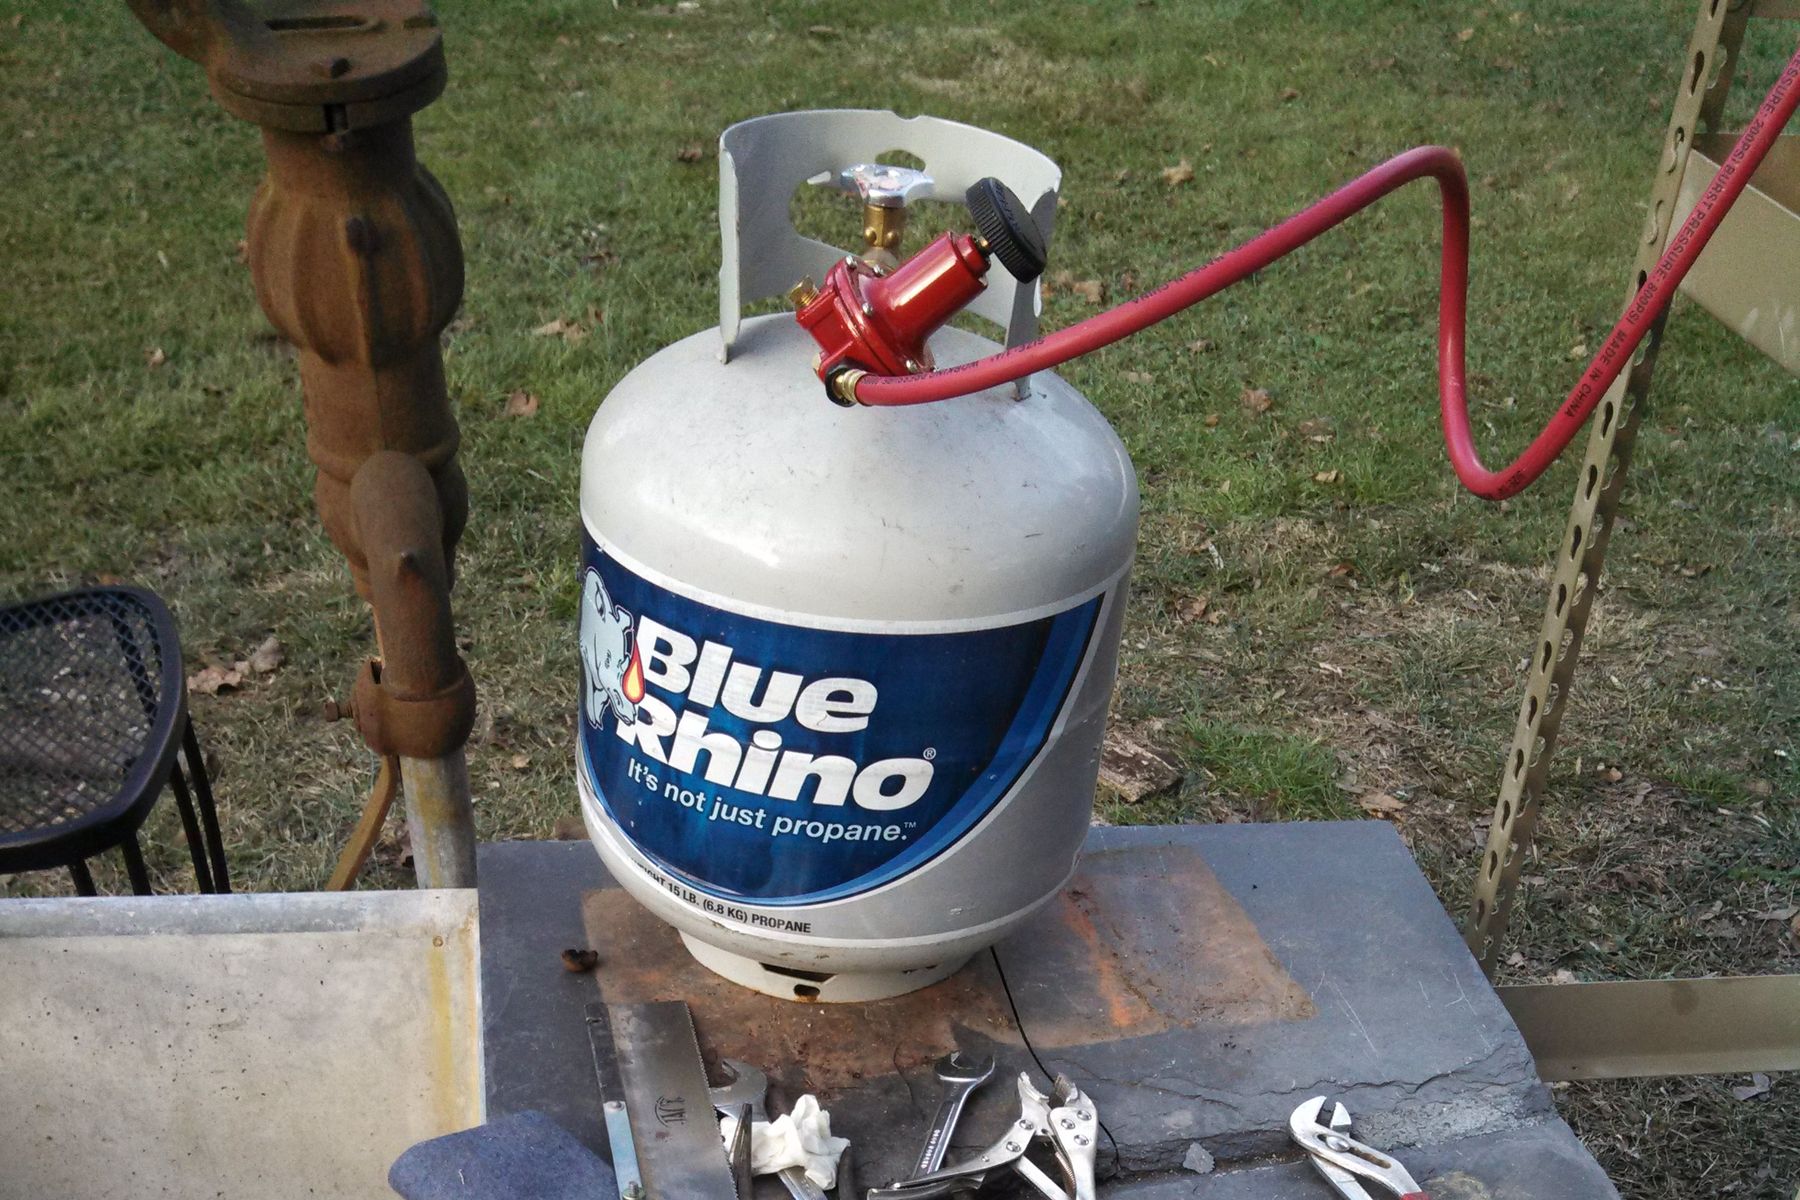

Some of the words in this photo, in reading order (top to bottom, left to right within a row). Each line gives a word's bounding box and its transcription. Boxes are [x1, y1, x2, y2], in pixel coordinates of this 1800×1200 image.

[1701, 164, 1736, 210] BURST
[1653, 211, 1706, 282] PRESSURE:
[1627, 282, 1658, 325] 800PSI
[1601, 329, 1627, 365] MADE
[1589, 367, 1603, 381] IN
[1564, 383, 1592, 418] CHINA
[636, 614, 878, 733] Blue
[627, 758, 658, 791] It's
[664, 783, 706, 812] not
[709, 796, 766, 829] just
[668, 883, 680, 897] 15
[683, 890, 699, 906] LB.
[703, 898, 725, 915] (6.8
[727, 907, 748, 923] KG)
[751, 913, 811, 934] PROPANE
